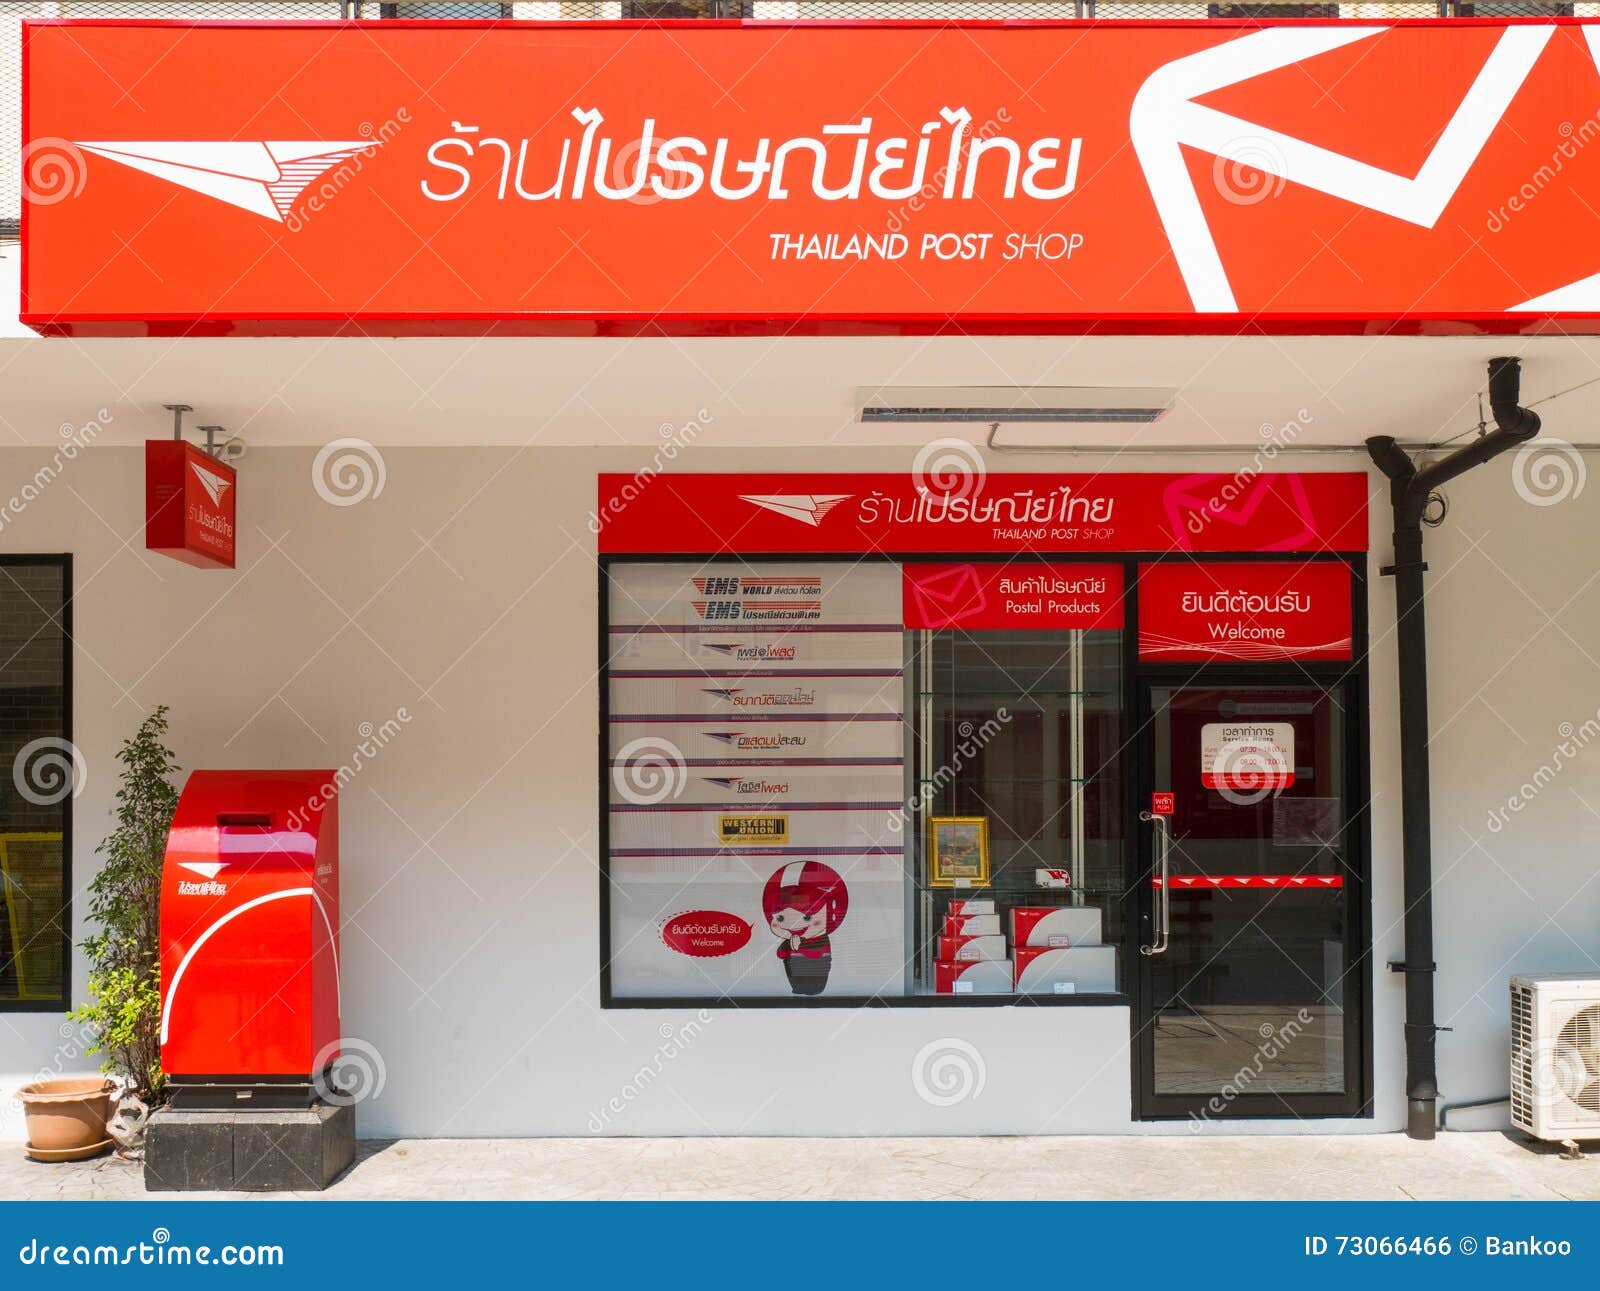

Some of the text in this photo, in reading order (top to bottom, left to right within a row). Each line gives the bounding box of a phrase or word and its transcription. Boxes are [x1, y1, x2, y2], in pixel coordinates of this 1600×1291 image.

[421, 106, 1083, 201] ร้านไปรษณีย์ไทย
[769, 233, 1084, 260] THAILAND POST SHOP
[858, 486, 1114, 523] ร้านไปรษณีย์ไทย
[992, 528, 1115, 540] THAILAND POST SHOP
[704, 577, 739, 595] EMS
[742, 586, 772, 595] WORLD
[999, 576, 1106, 594] สินค้าไปรษณีย์
[705, 601, 742, 619] EMS
[1006, 600, 1101, 614] Postal Products
[1181, 589, 1311, 613] ยินดีต้อนรับ
[1208, 620, 1286, 639] Welcome
[1222, 725, 1275, 737] เวลาทำการ
[723, 819, 775, 827] WESTERN
[691, 938, 725, 946] Welcome
